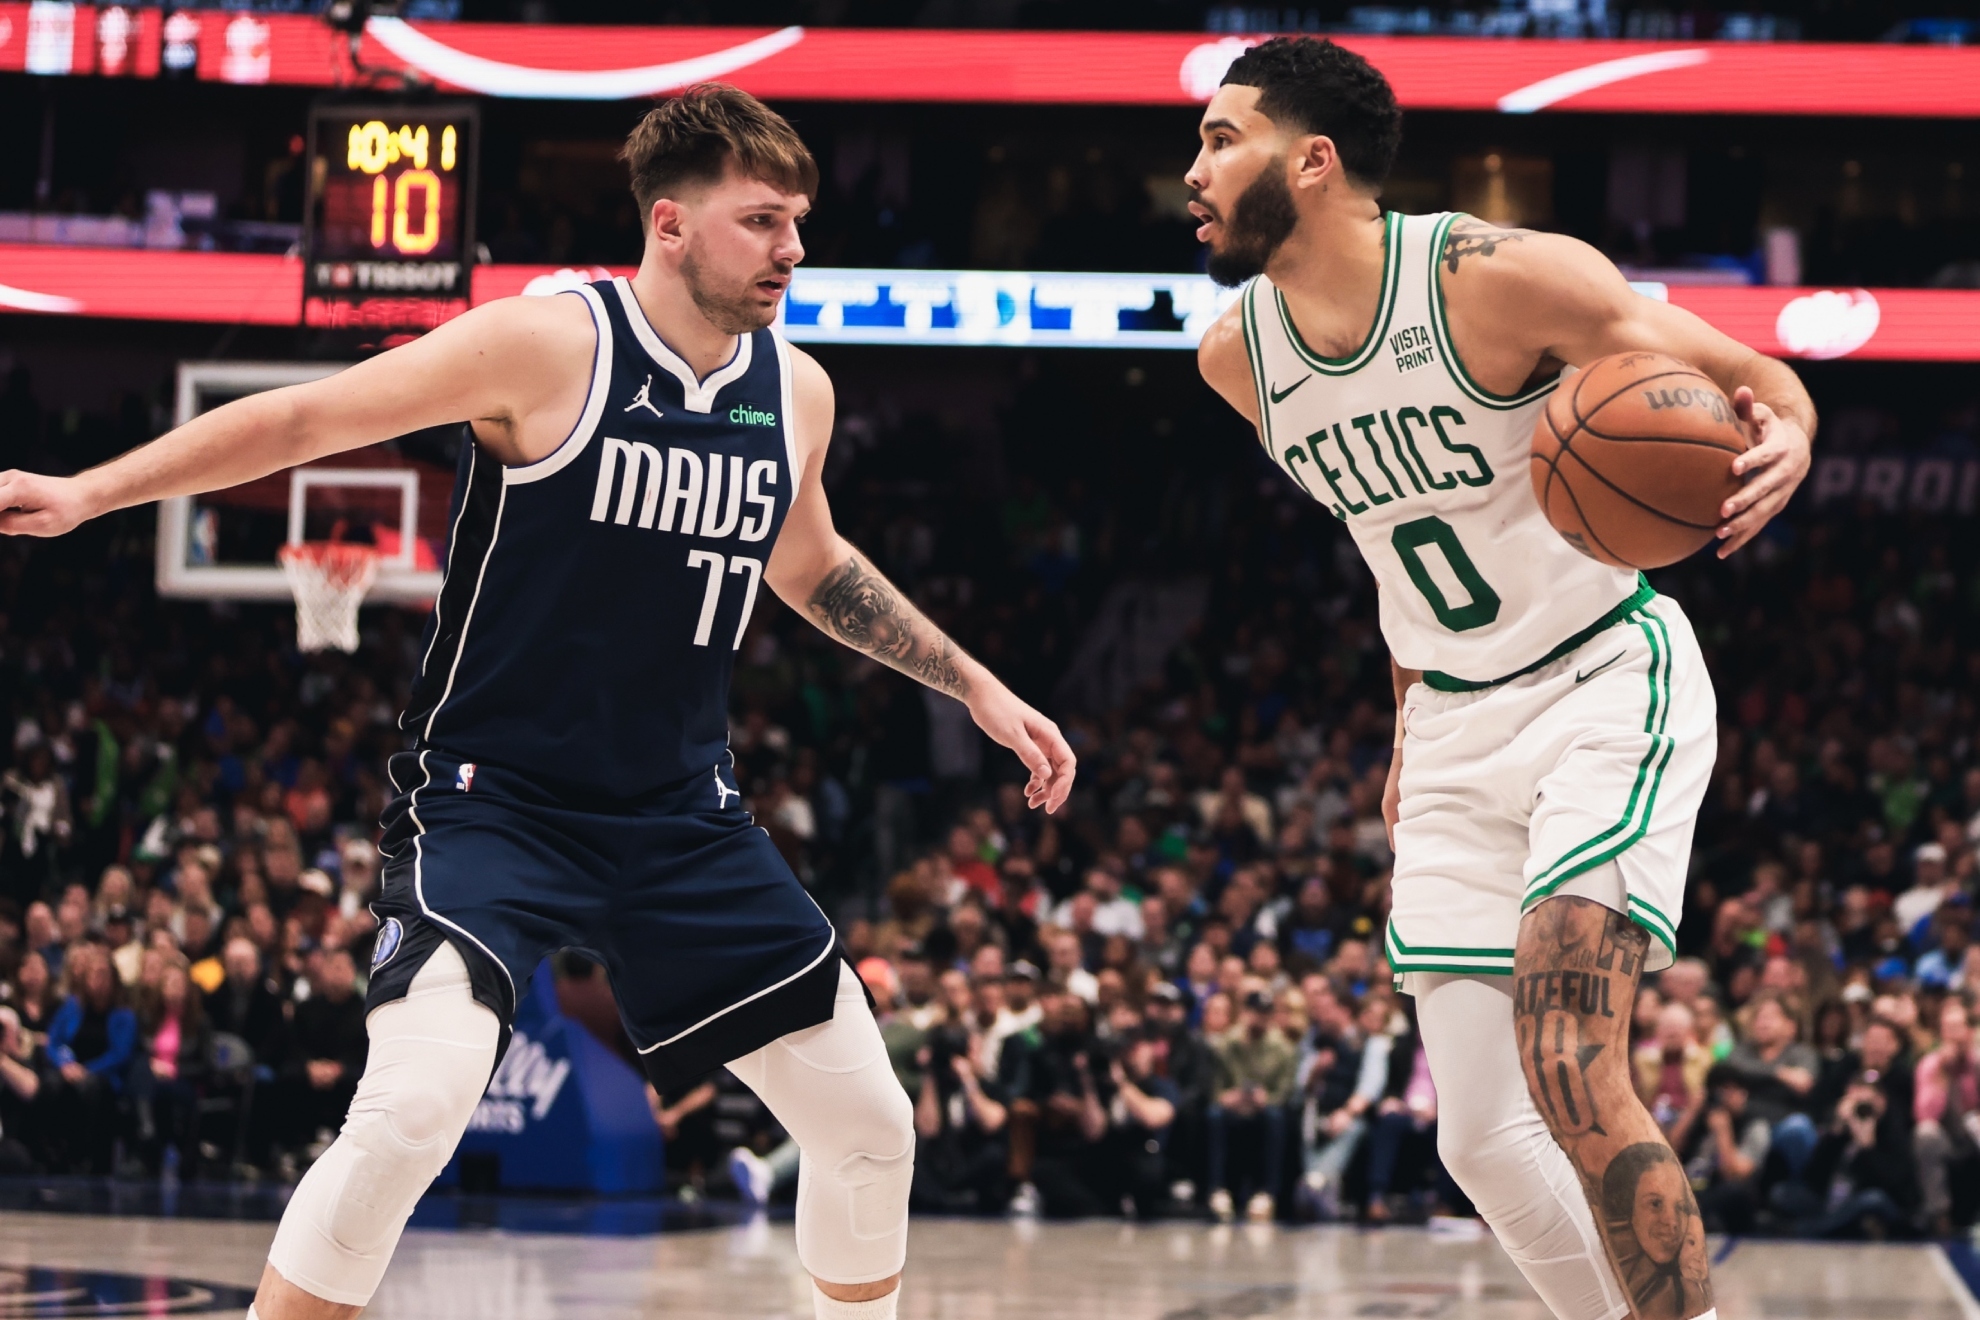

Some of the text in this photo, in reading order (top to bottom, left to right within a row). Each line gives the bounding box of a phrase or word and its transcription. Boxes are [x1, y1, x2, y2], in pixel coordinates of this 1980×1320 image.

[347, 121, 457, 174] 10:41
[370, 169, 441, 254] 10
[355, 262, 461, 291] TISSOT
[1389, 325, 1431, 356] VISTA
[1395, 346, 1434, 373] PRINT
[729, 404, 776, 427] chime
[590, 437, 777, 542] MAVS
[1285, 405, 1495, 522] CELTICS
[687, 549, 762, 651] 77
[1391, 515, 1501, 633] 0
[1514, 970, 1615, 1018] ATEFUL
